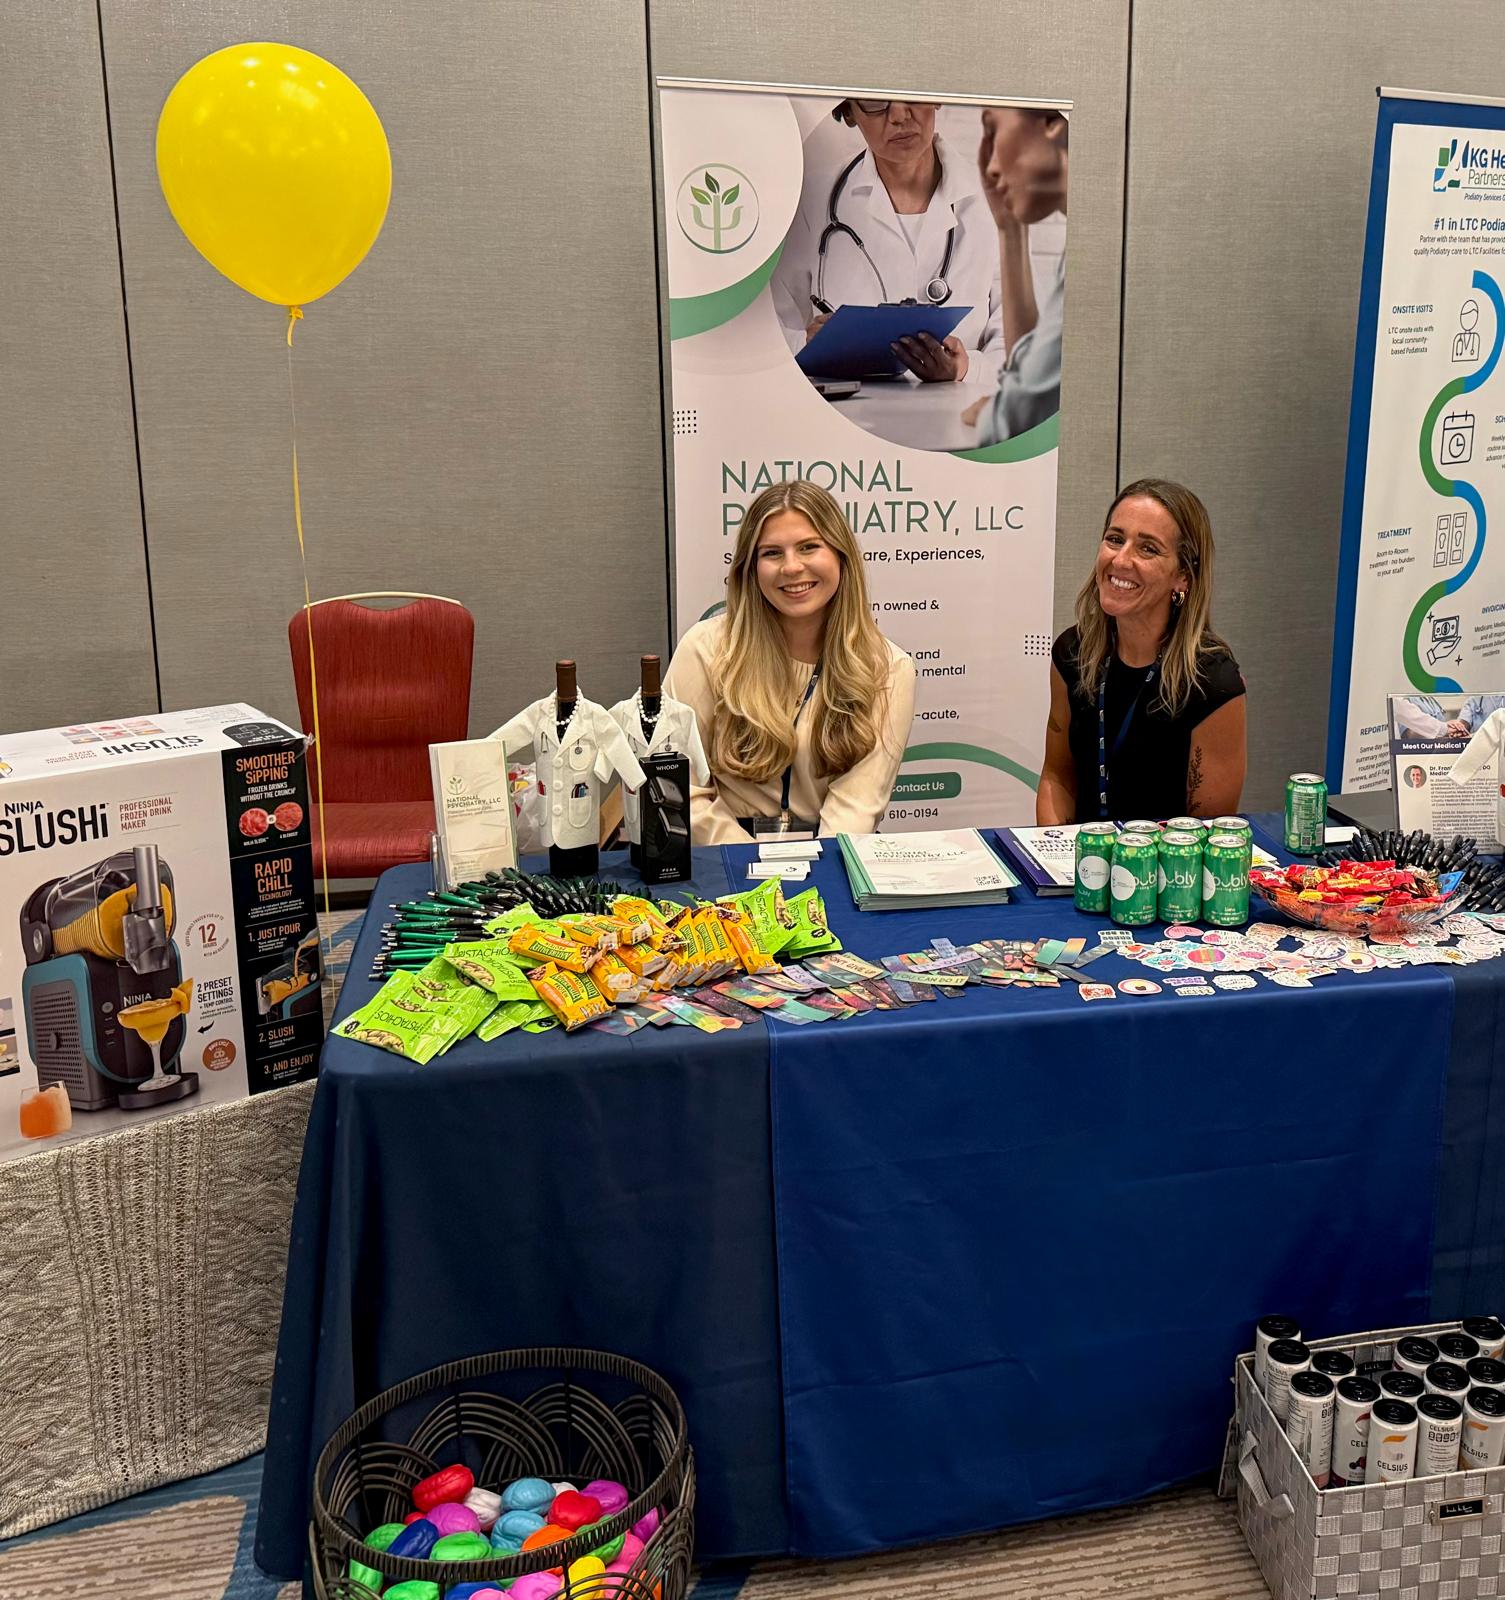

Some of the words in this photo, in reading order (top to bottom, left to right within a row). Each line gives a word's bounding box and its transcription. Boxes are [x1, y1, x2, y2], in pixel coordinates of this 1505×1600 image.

[1470, 147, 1489, 168] KG
[1434, 217, 1445, 231] #1
[1447, 217, 1458, 231] in
[1459, 217, 1479, 231] LTC
[1392, 304, 1415, 314] ONSITE
[1416, 304, 1434, 313] VISITS
[721, 460, 913, 494] NATIONAL
[721, 500, 960, 536] PIATRY,
[975, 505, 1025, 532] LLC
[1377, 527, 1412, 540] TREATMENT
[863, 549, 891, 564] are,
[895, 547, 985, 565] Experiences,
[883, 599, 927, 612] owned
[929, 599, 940, 611] &
[915, 648, 941, 660] and
[922, 664, 966, 677] mental
[1434, 741, 1462, 750] Medical
[235, 750, 296, 772] SMOOTHER
[931, 780, 945, 791] Us
[119, 796, 173, 813] PROFESSIONAL
[447, 794, 481, 803] NATIONAL
[447, 800, 488, 809] PSYCHIATRY,
[4, 800, 45, 817] NINJA
[120, 811, 148, 822] FROZEN
[149, 805, 173, 817] DRINK
[888, 807, 939, 820] 610-0194
[120, 820, 147, 831] MAKER
[254, 857, 293, 879] RAPID
[198, 922, 217, 944] 12
[257, 927, 277, 941] JUST
[278, 922, 301, 936] POUR
[197, 983, 202, 993] 2
[203, 976, 233, 992] PRESET
[123, 993, 152, 1008] NINJA
[197, 986, 234, 1003] SETTINGS
[259, 1032, 267, 1042] 2.
[268, 1024, 295, 1040] SLUSH
[272, 1059, 289, 1073] AND
[290, 1053, 314, 1067] ENJOY
[1430, 1424, 1455, 1432] CELSIUS
[1377, 1460, 1408, 1472] CELSIUS
